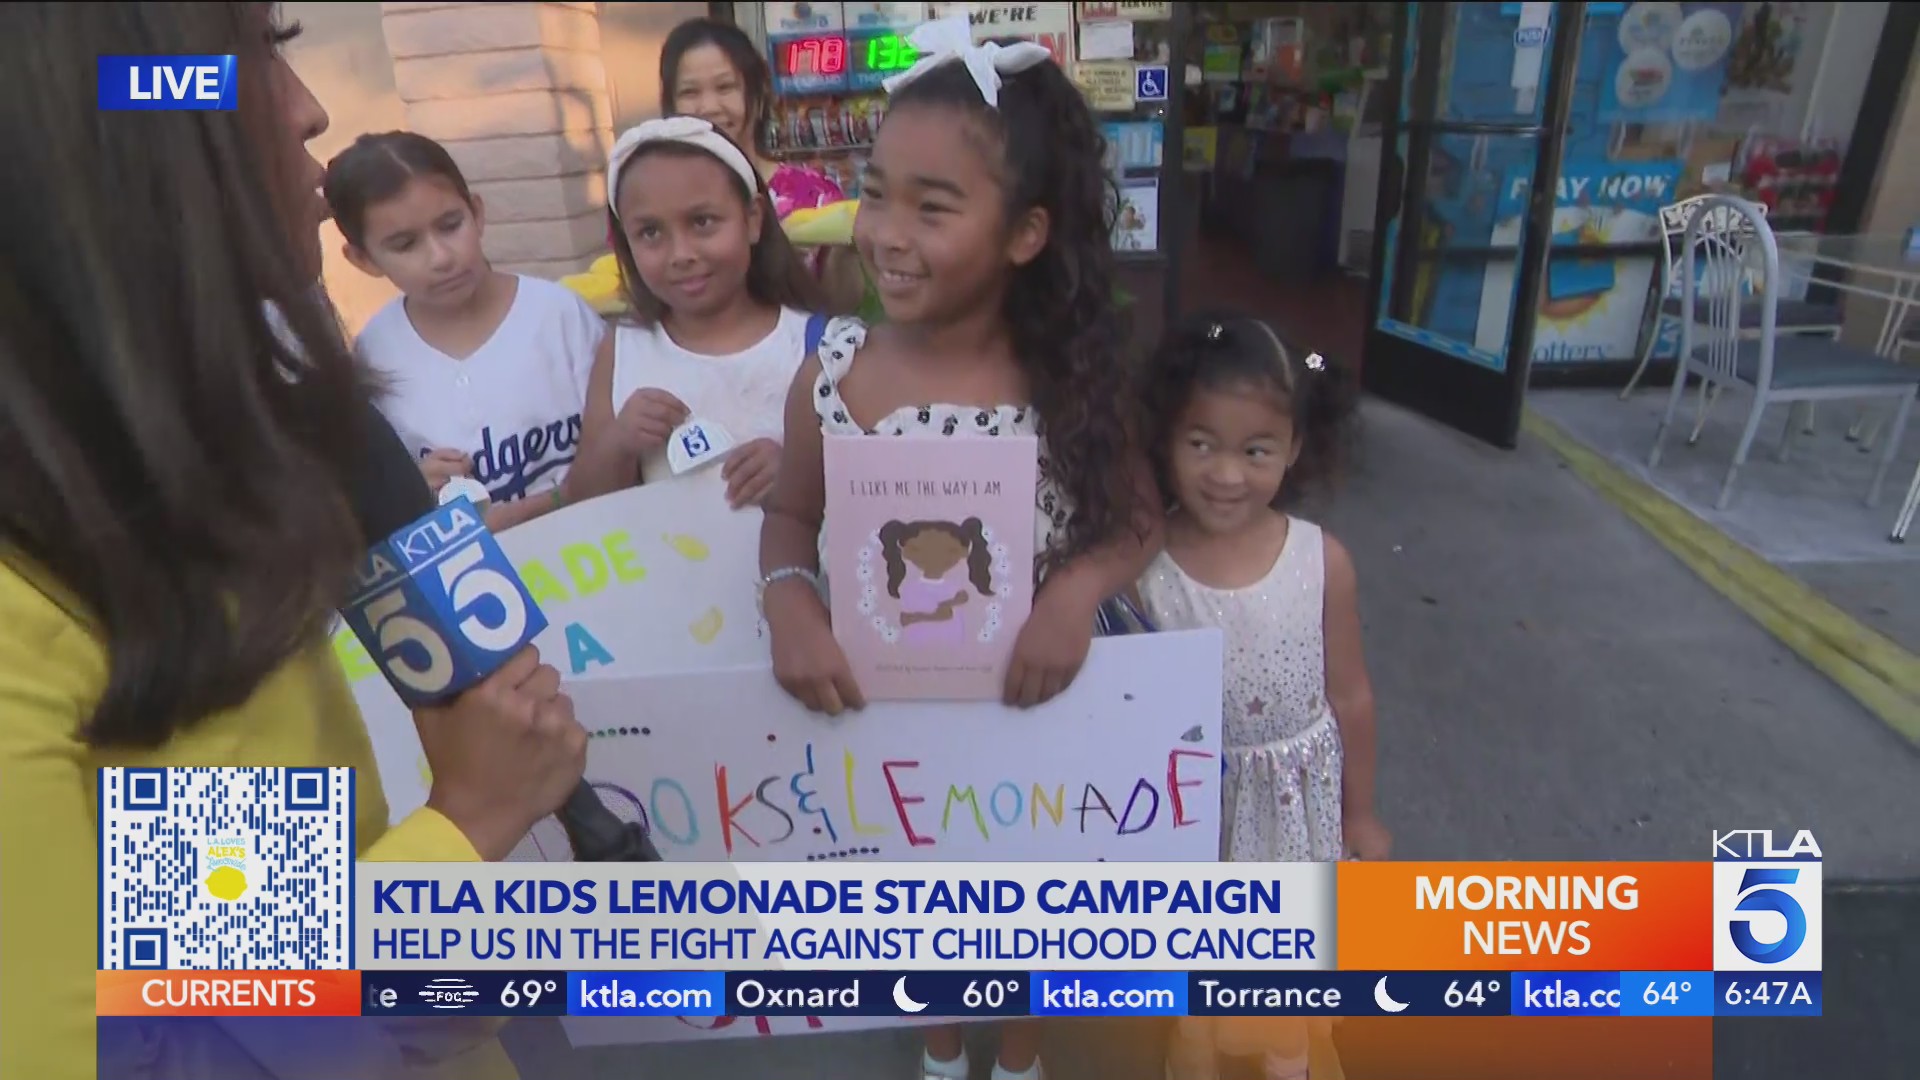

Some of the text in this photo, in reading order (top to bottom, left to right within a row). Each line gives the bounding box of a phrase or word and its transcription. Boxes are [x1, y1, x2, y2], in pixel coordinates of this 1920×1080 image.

[969, 6, 1037, 24] WE'RE
[789, 38, 843, 74] 178
[1511, 175, 1667, 200] PAY NOW
[1531, 340, 1605, 361] ottery
[861, 480, 888, 496] LIKE
[895, 480, 911, 496] ME
[917, 479, 935, 496] THE
[943, 480, 968, 496] WAY
[984, 480, 1001, 496] AM
[397, 508, 476, 563] KTLA
[358, 554, 397, 587] LA
[438, 541, 528, 651] 5
[364, 588, 454, 693] 5
[844, 748, 1214, 847] LEMONADE
